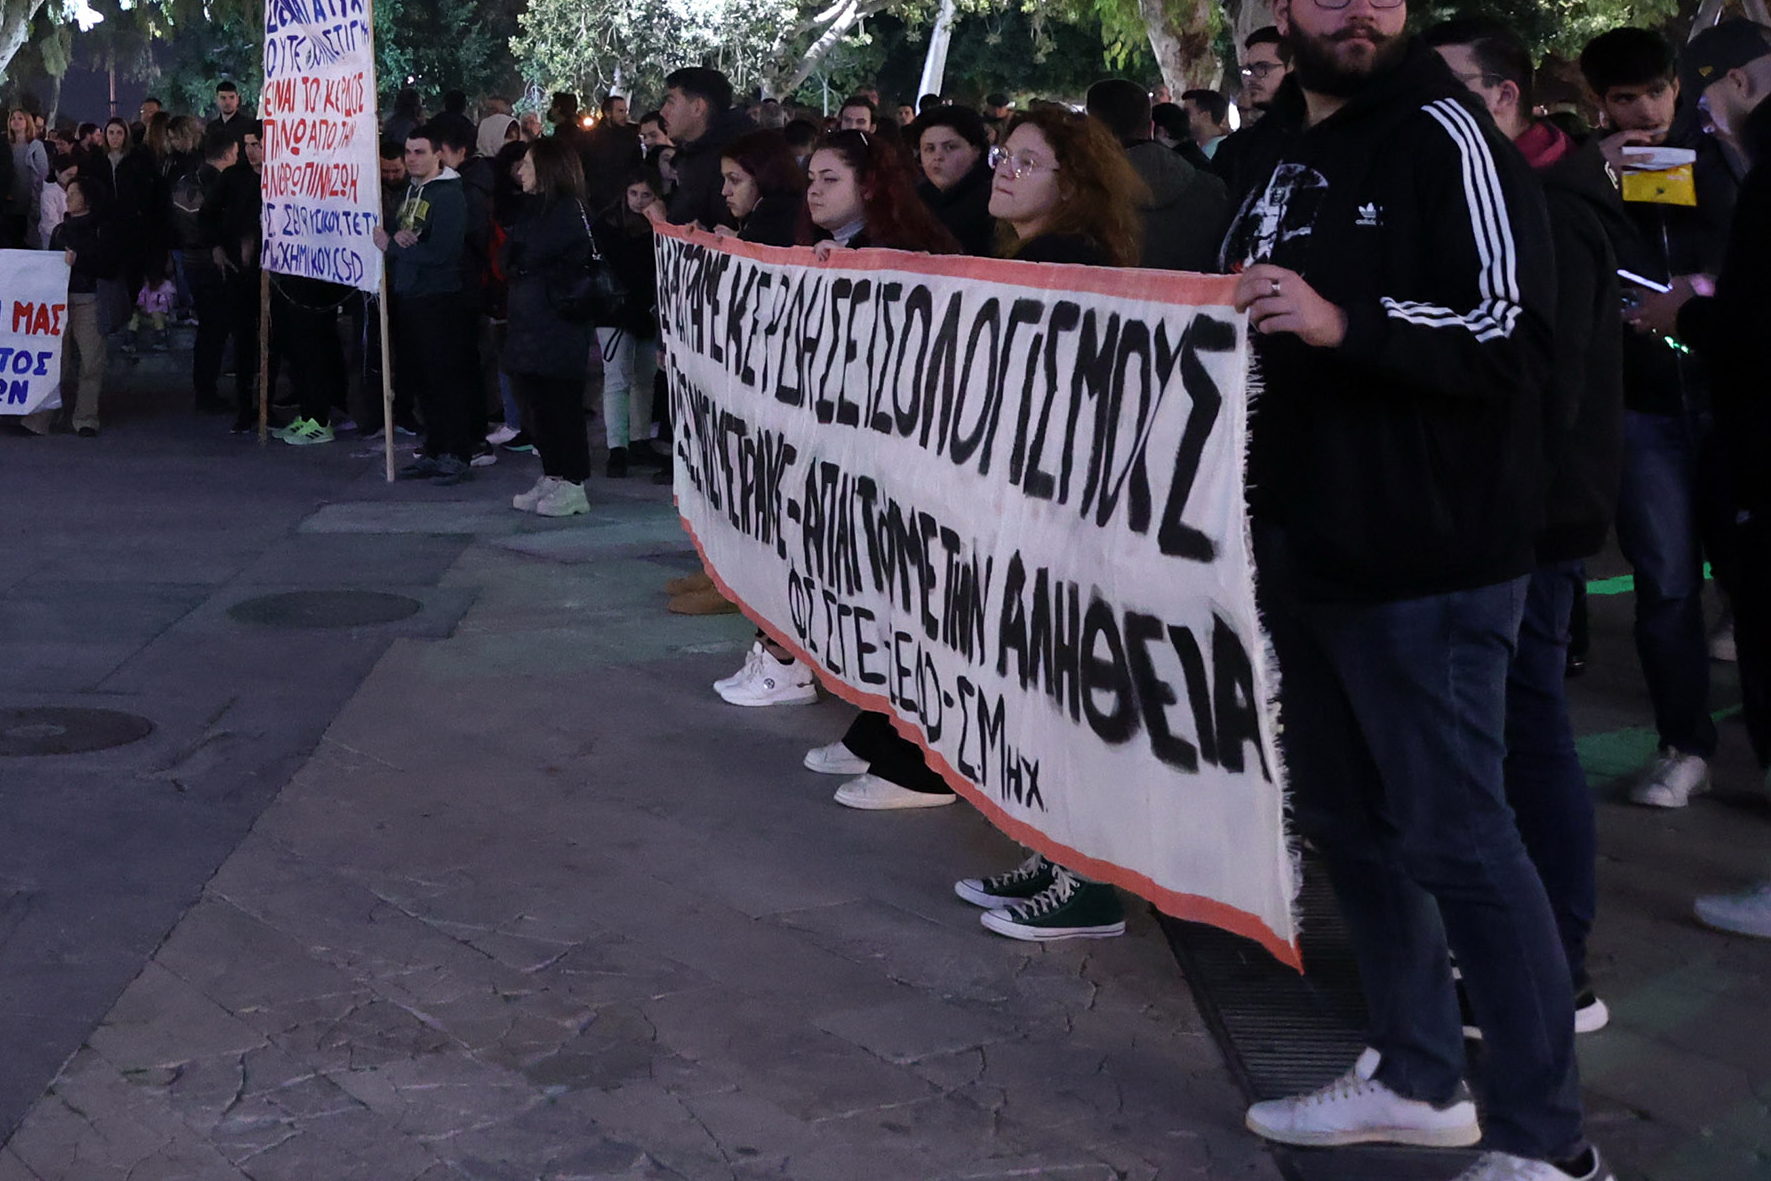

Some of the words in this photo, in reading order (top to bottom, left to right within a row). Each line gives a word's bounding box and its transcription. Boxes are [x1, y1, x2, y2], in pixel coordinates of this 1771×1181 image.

[302, 75, 320, 109] ΤΟ
[323, 71, 363, 117] ΚΕΡΔΟΣ
[327, 163, 359, 204] ΖΩΗ
[11, 301, 66, 337] ΜΑΣ
[997, 549, 1273, 783] ΑΛΗΘΕΙΑ
